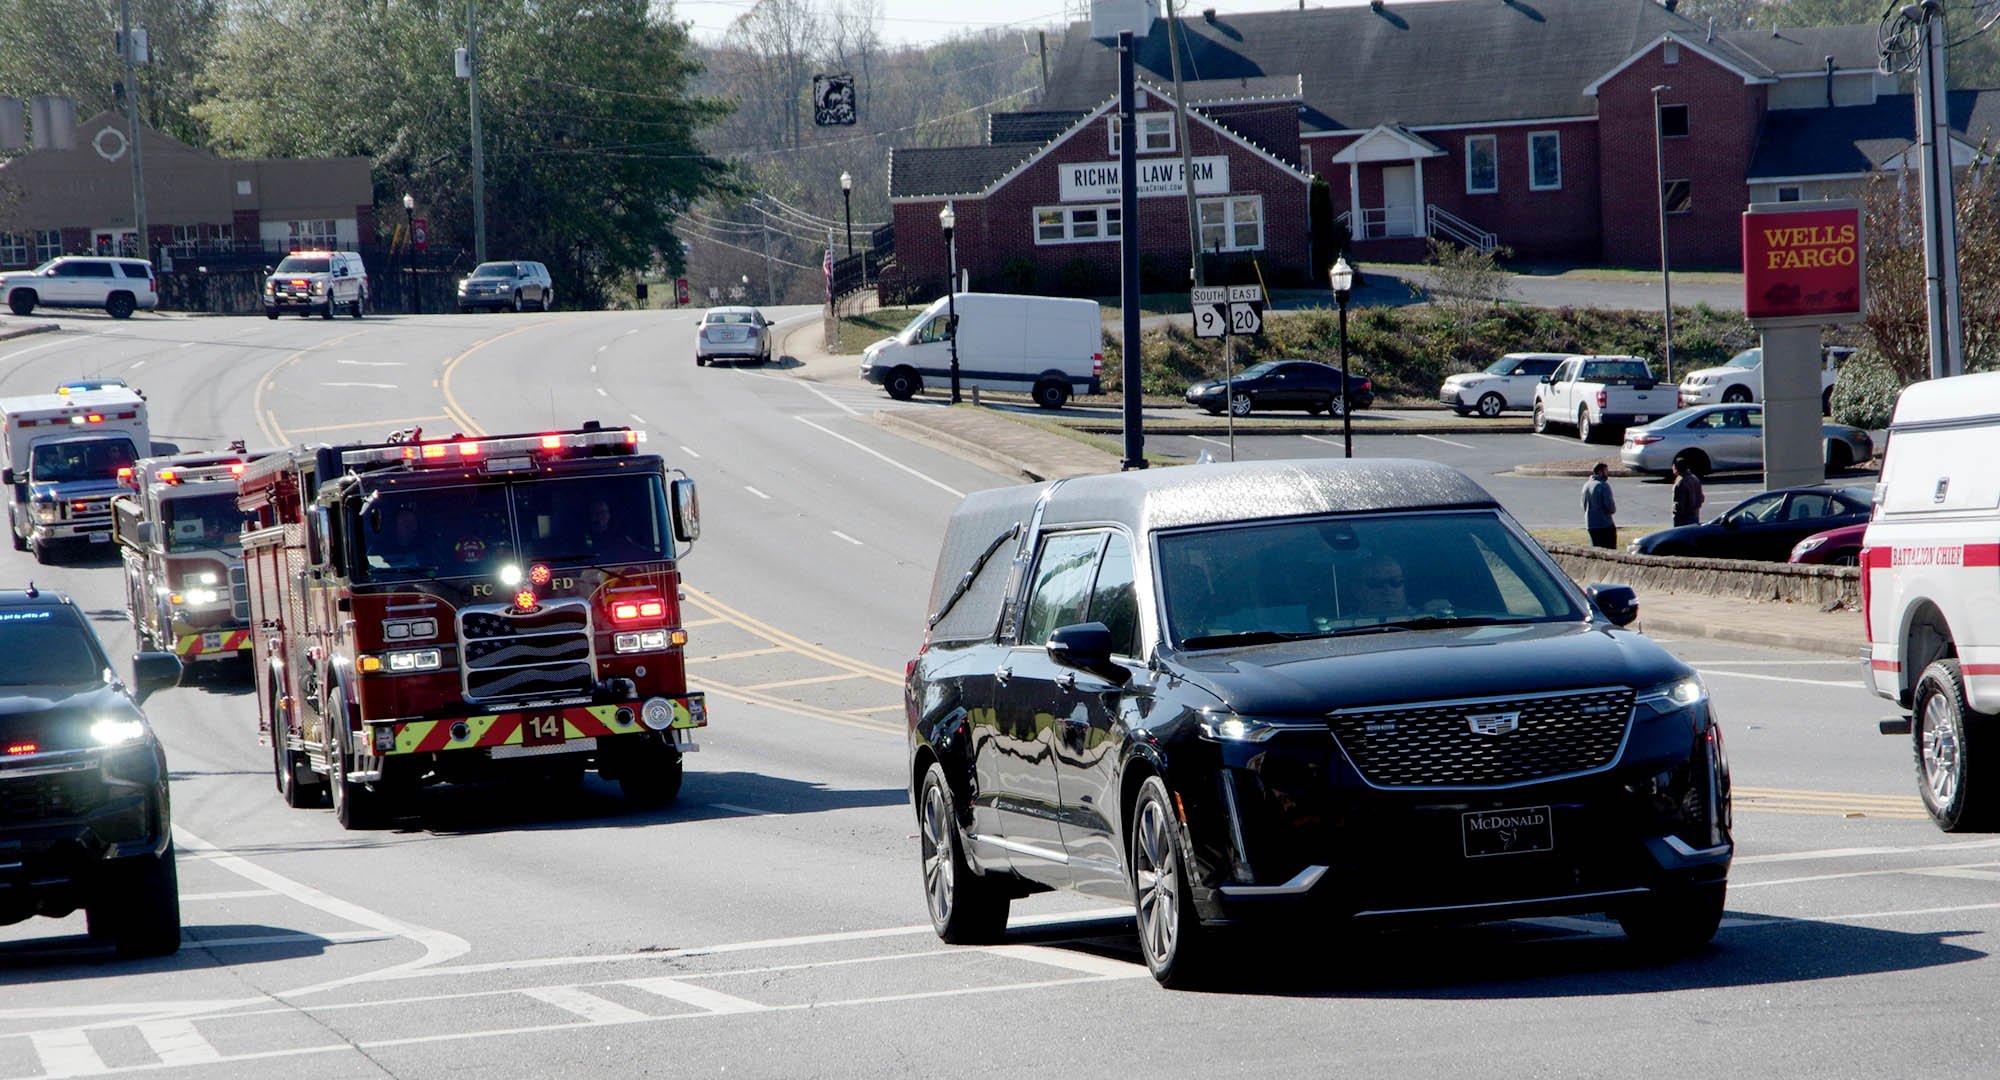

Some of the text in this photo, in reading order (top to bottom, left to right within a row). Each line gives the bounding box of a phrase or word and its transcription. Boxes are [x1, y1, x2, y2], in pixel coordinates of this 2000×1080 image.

[1143, 164, 1173, 183] LAW
[1180, 162, 1213, 181] FRM
[1764, 224, 1855, 248] WELLS
[1767, 246, 1855, 269] FARGO
[1194, 290, 1224, 301] SOUTH
[1232, 288, 1257, 300] EAST
[1202, 312, 1214, 330] 9
[1235, 310, 1254, 329] 20
[1893, 546, 1962, 566] BATTALION CHIEF
[472, 577, 574, 597] FC FD
[529, 715, 559, 738] 14
